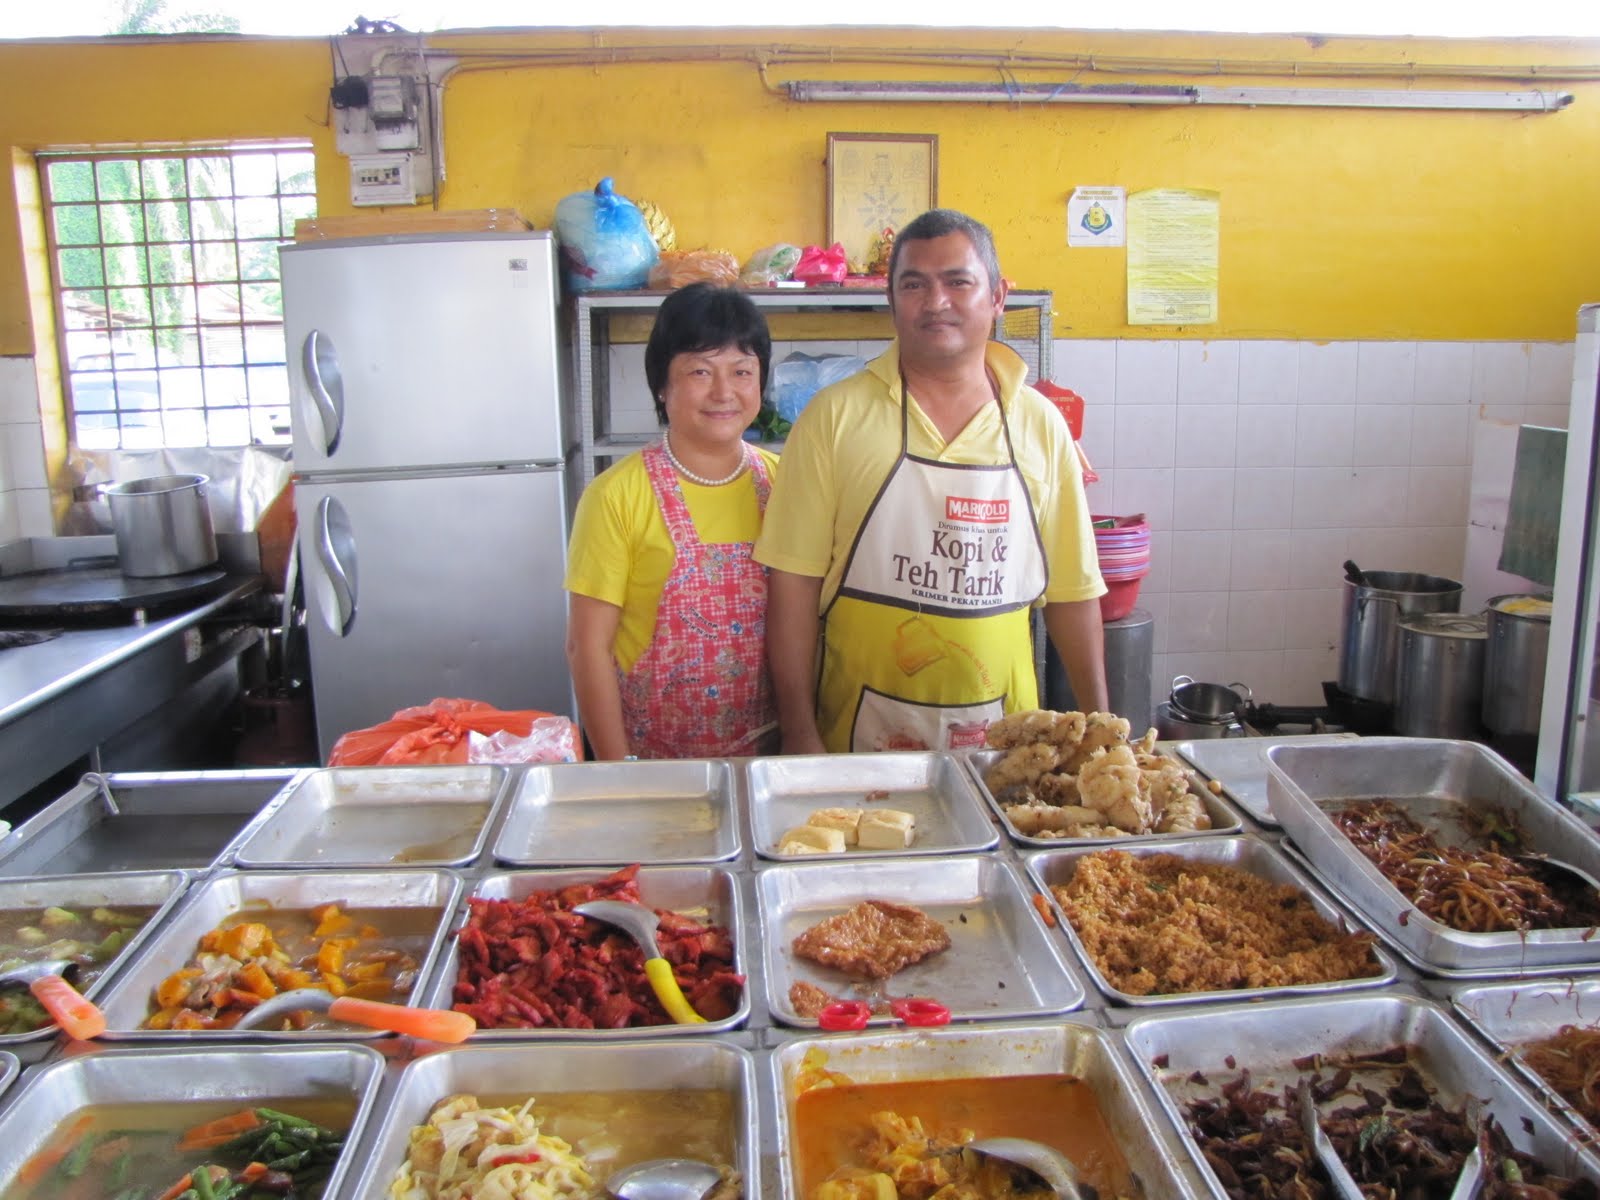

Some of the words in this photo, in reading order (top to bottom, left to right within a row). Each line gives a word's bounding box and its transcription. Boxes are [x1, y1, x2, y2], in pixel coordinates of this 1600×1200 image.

[949, 499, 1007, 520] MARIGOLD
[987, 526, 1008, 534] untuk
[931, 530, 984, 567] Kopi
[992, 536, 1008, 563] &
[893, 554, 938, 590] Teh
[949, 567, 1005, 596] Tarik
[912, 588, 948, 602] KRIMER
[951, 596, 979, 606] PEKAT
